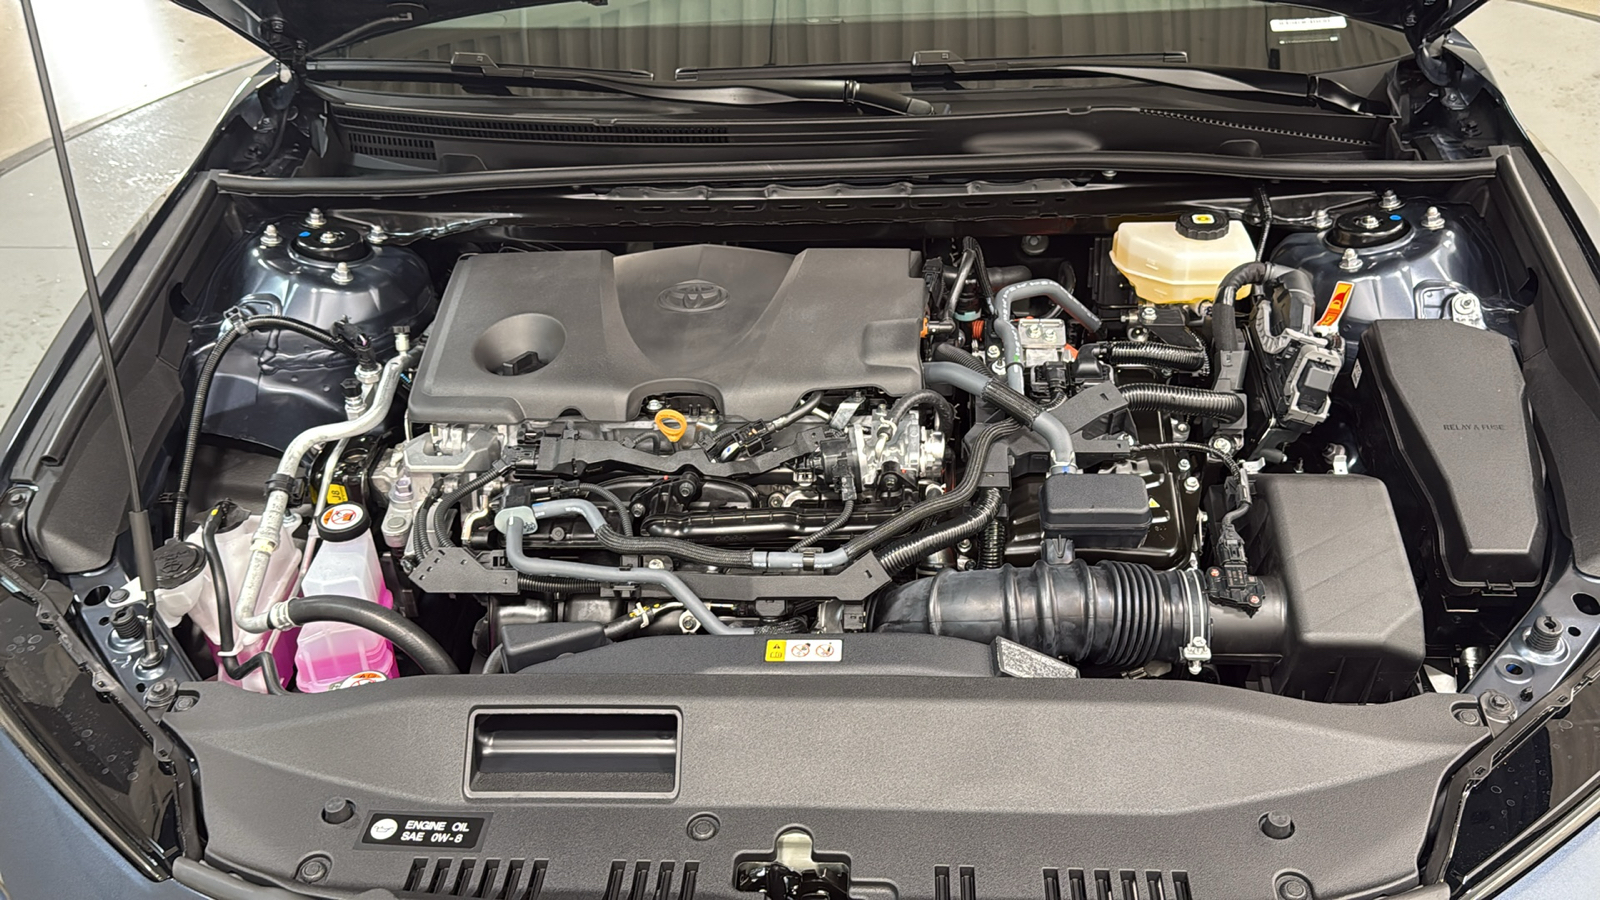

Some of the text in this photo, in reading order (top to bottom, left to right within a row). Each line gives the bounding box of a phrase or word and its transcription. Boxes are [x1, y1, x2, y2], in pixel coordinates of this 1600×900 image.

[404, 820, 470, 832] ENGINE OIL
[400, 831, 463, 843] SAE 0W-8
